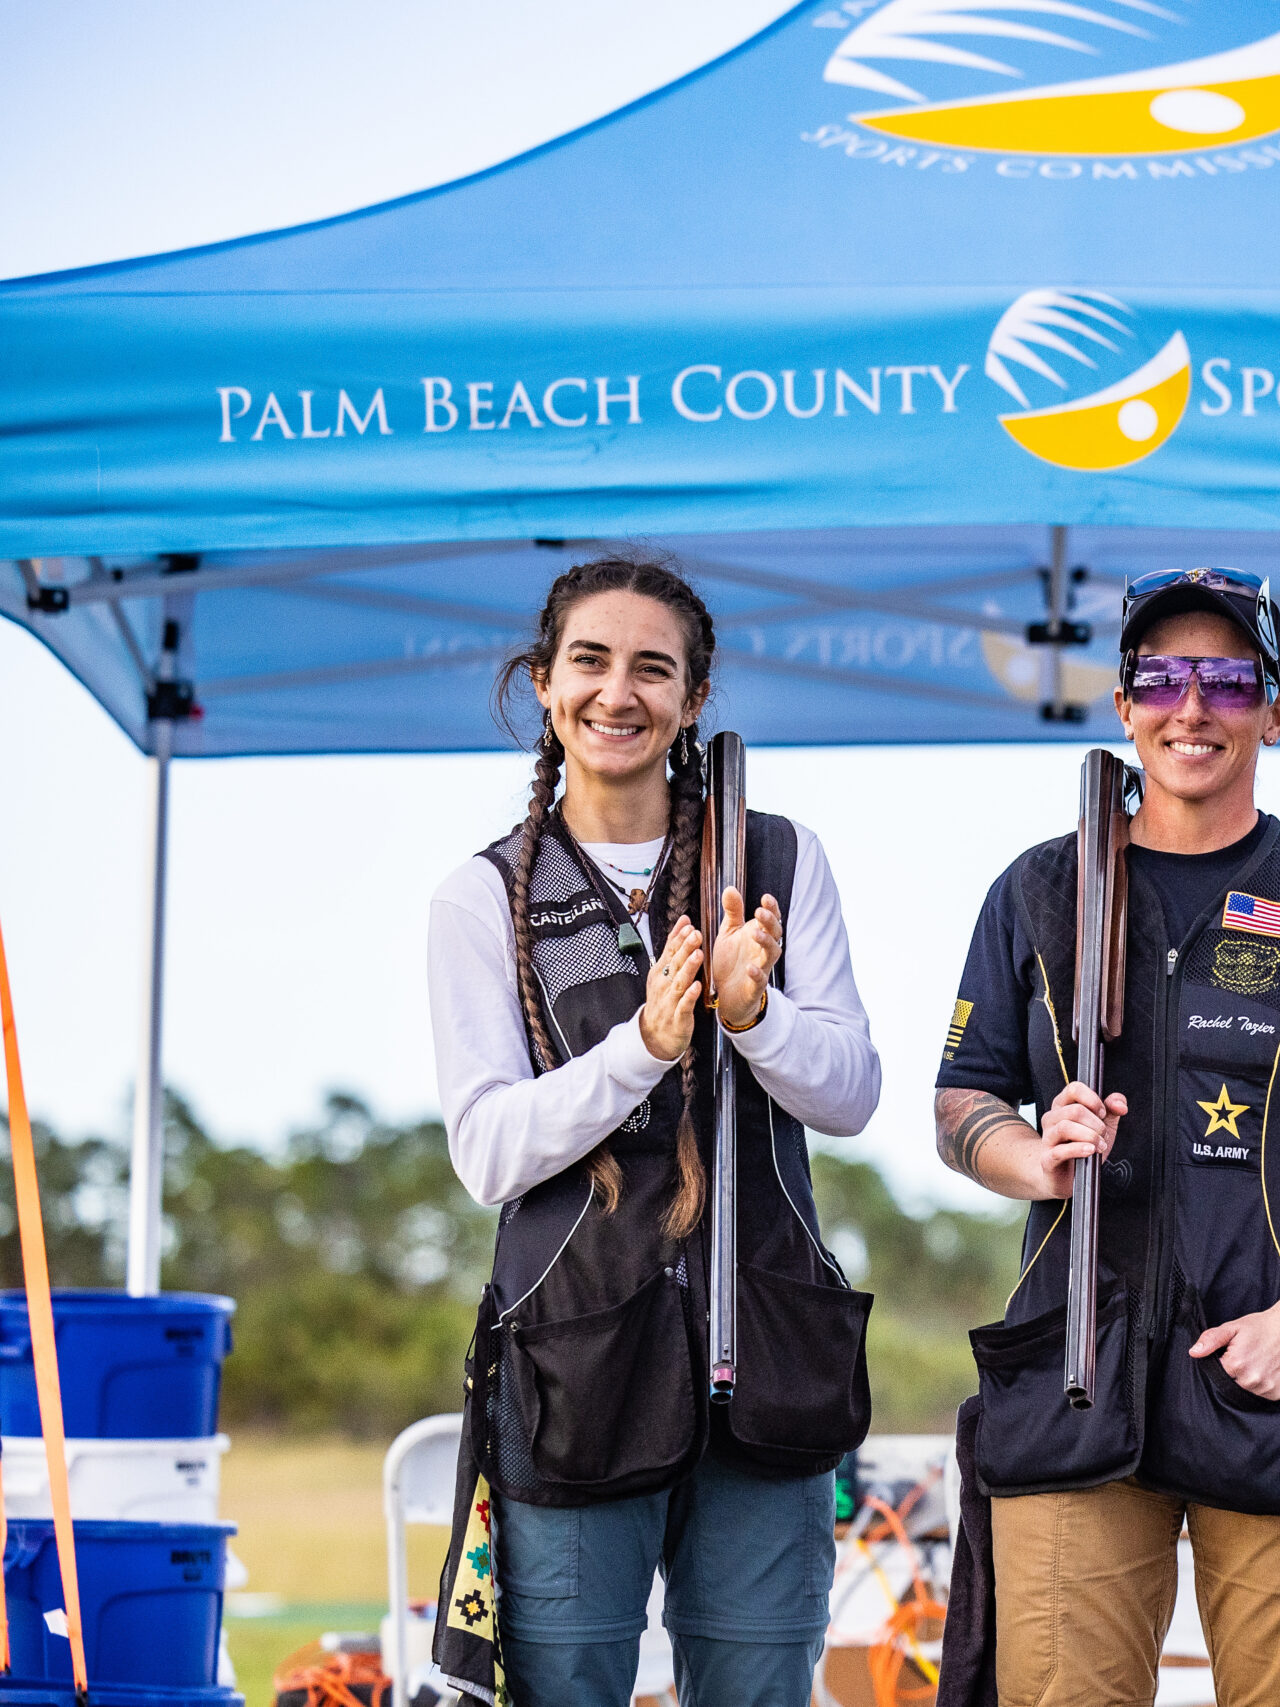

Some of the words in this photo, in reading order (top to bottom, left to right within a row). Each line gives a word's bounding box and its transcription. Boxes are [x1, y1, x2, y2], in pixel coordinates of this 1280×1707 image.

[802, 124, 970, 174] SPORTS
[216, 385, 394, 443] PALM
[420, 375, 643, 434] BEACH
[671, 364, 971, 423] COUNTY
[1187, 1014, 1234, 1030] Rachel
[1237, 1015, 1276, 1036] Tozier
[1192, 1142, 1215, 1157] U.S.
[1214, 1145, 1250, 1160] ARMY
